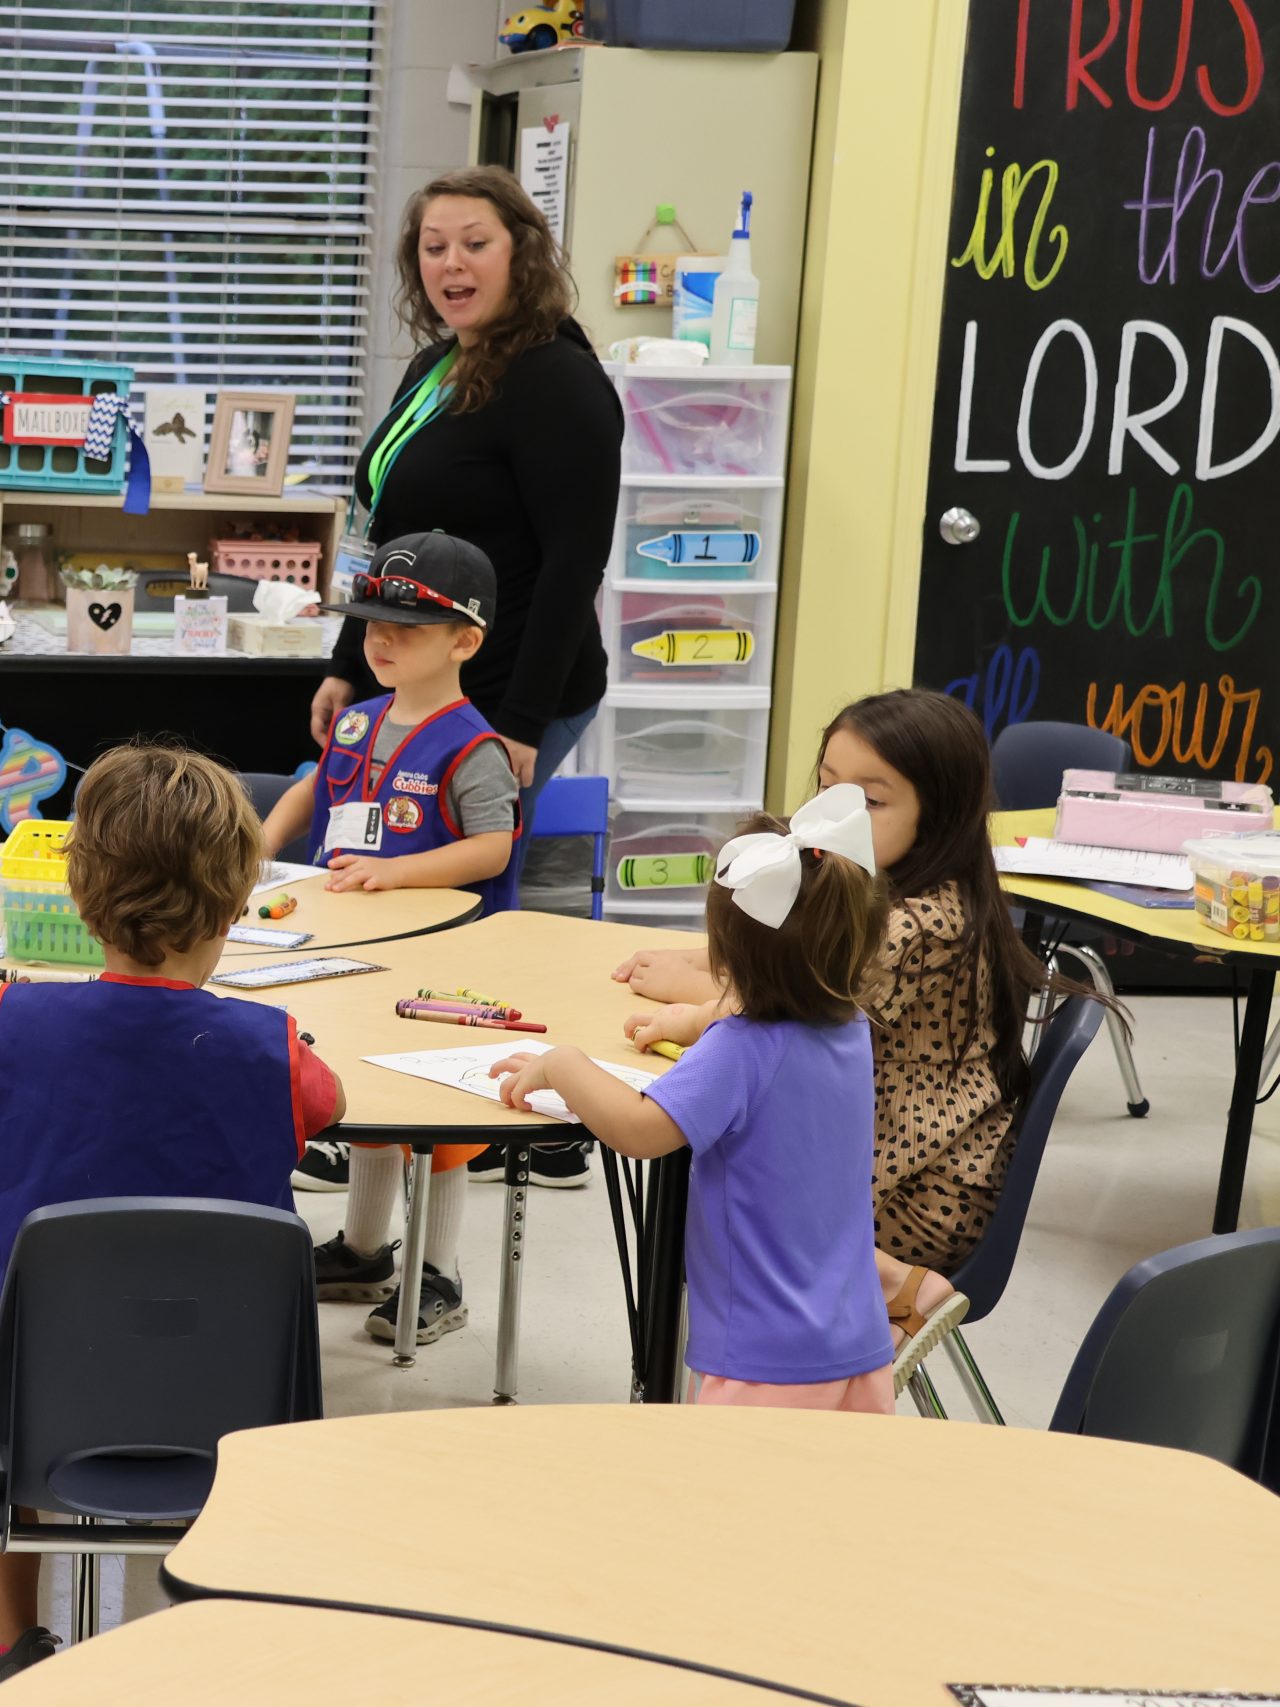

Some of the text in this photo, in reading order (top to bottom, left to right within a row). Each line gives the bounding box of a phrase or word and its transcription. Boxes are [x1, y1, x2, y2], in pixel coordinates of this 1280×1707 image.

[951, 126, 1280, 293] in the
[954, 315, 1280, 481] LORD
[17, 408, 90, 433] MAILBOXE
[693, 535, 717, 560] 1
[1001, 483, 1262, 650] with
[692, 634, 714, 660] 2
[1086, 674, 1273, 785] your
[392, 776, 439, 796] Cubbies
[650, 858, 669, 886] 3
